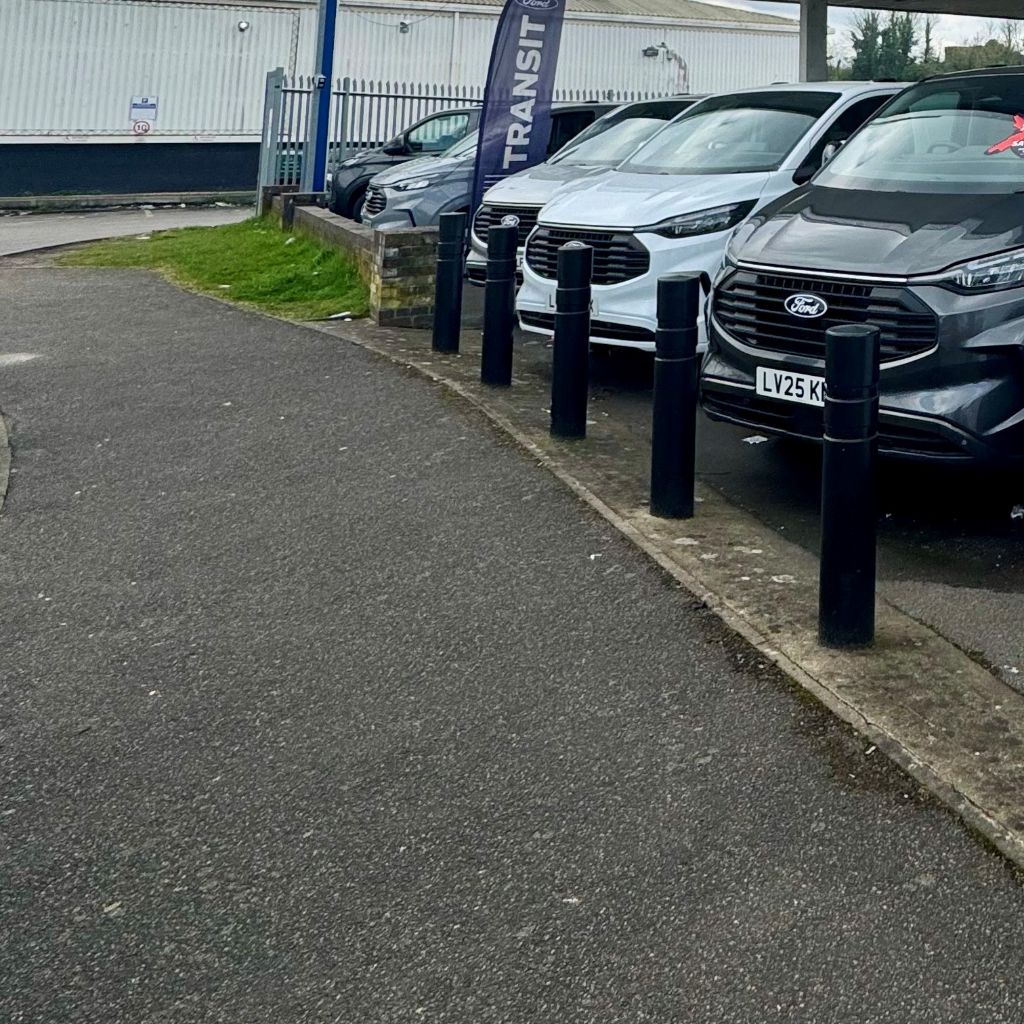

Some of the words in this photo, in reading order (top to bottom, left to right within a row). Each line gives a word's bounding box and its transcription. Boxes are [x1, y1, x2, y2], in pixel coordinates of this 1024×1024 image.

[502, 14, 547, 170] TRANSIT
[789, 295, 821, 316] Ford
[763, 371, 805, 399] LV25
